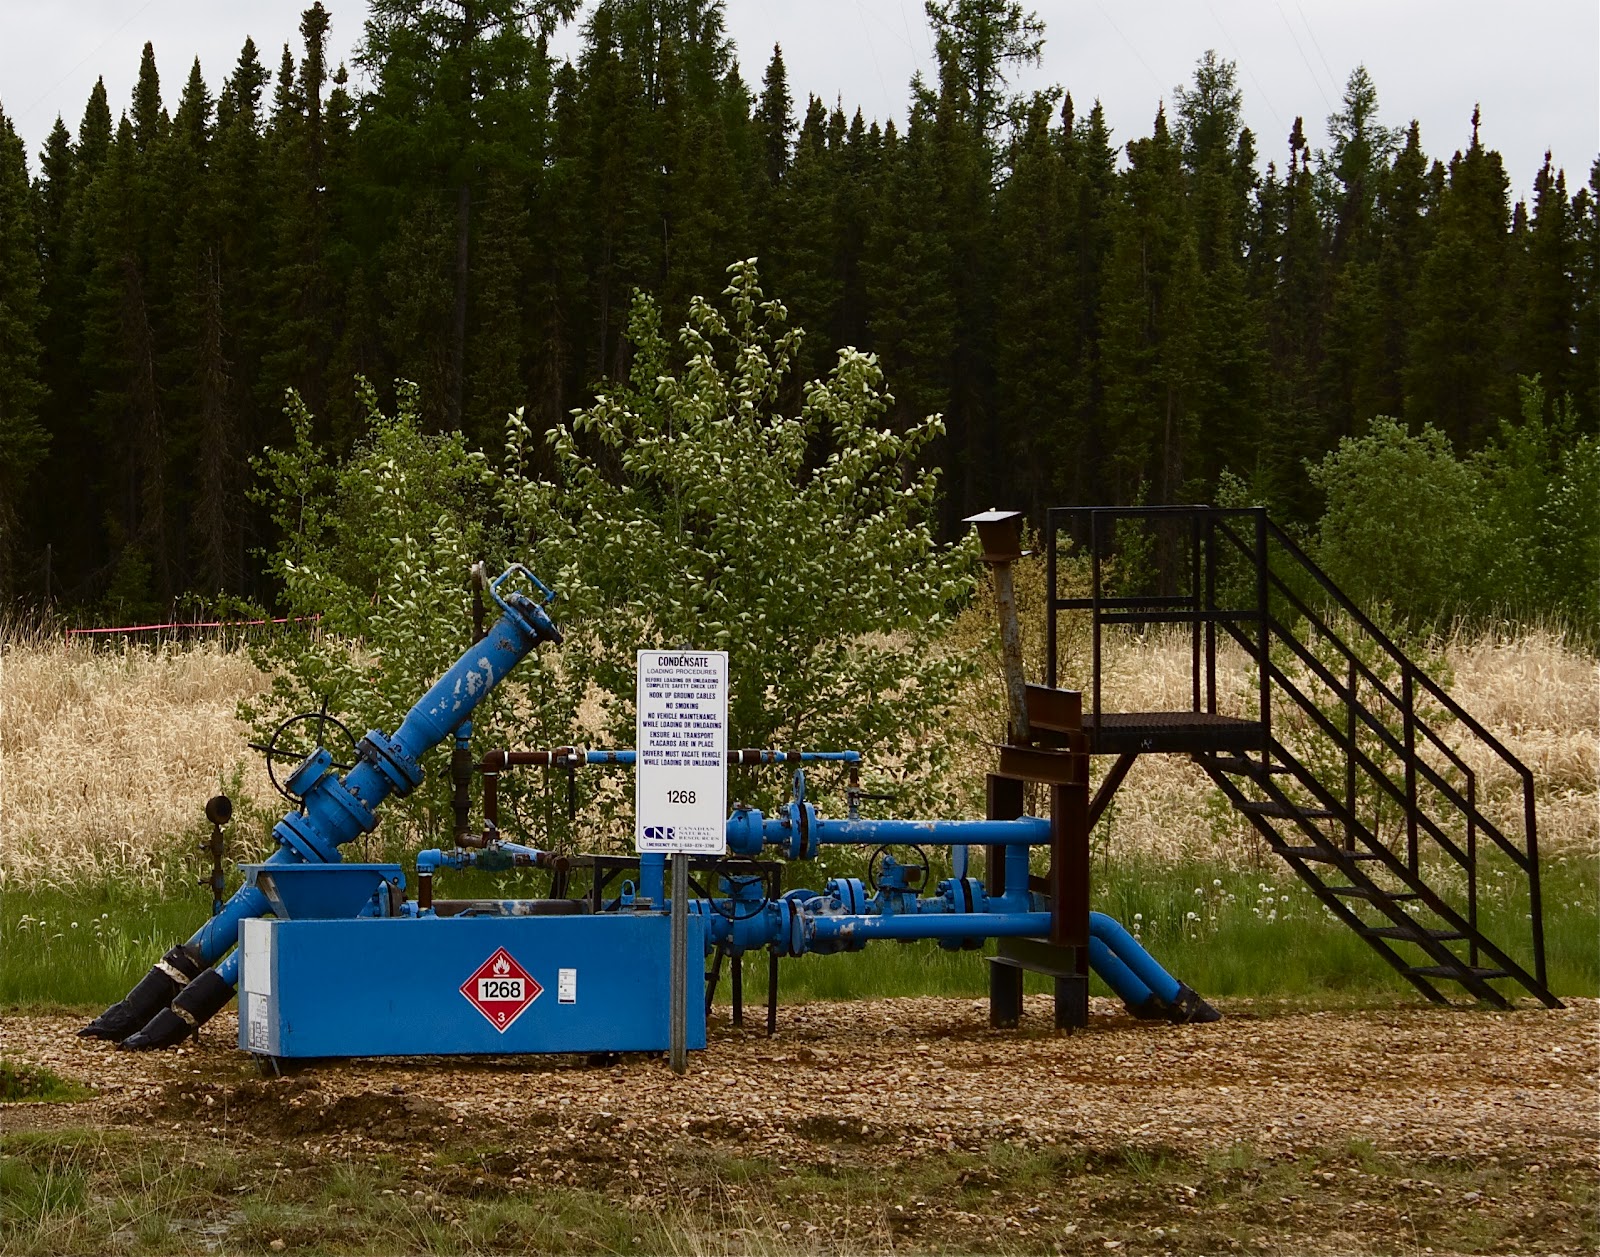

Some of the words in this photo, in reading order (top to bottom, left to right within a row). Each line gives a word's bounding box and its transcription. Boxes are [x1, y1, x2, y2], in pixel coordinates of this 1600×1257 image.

[658, 656, 708, 667] CONDENSATE
[667, 790, 696, 804] 1268
[643, 826, 675, 839] CNR
[482, 981, 521, 998] 1268
[498, 1012, 505, 1022] 3
